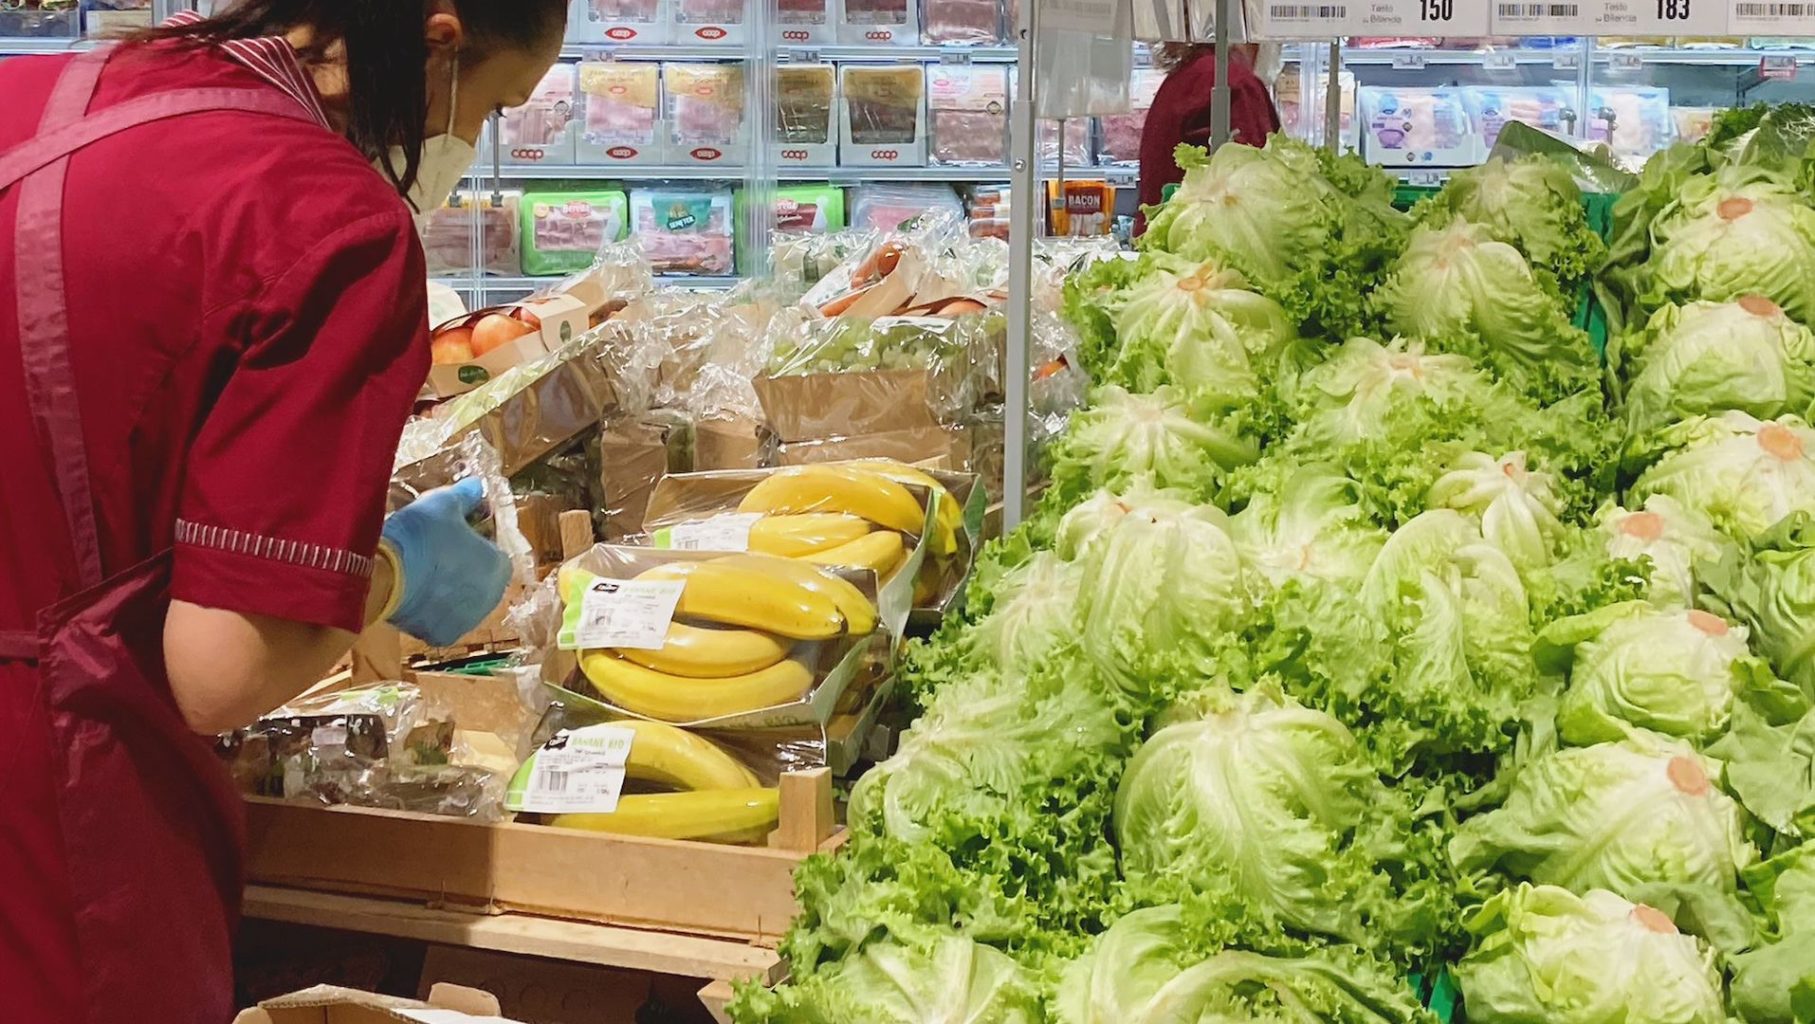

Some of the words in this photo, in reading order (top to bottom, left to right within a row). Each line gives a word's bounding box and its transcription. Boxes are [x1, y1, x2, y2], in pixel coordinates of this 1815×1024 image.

[1420, 0, 1453, 21] 150
[1657, 0, 1690, 20] 183
[783, 30, 809, 42] coop
[865, 31, 892, 42] coop
[511, 148, 544, 161] coop
[781, 150, 808, 160] coop
[871, 150, 898, 160] coop
[1068, 195, 1100, 206] BACON
